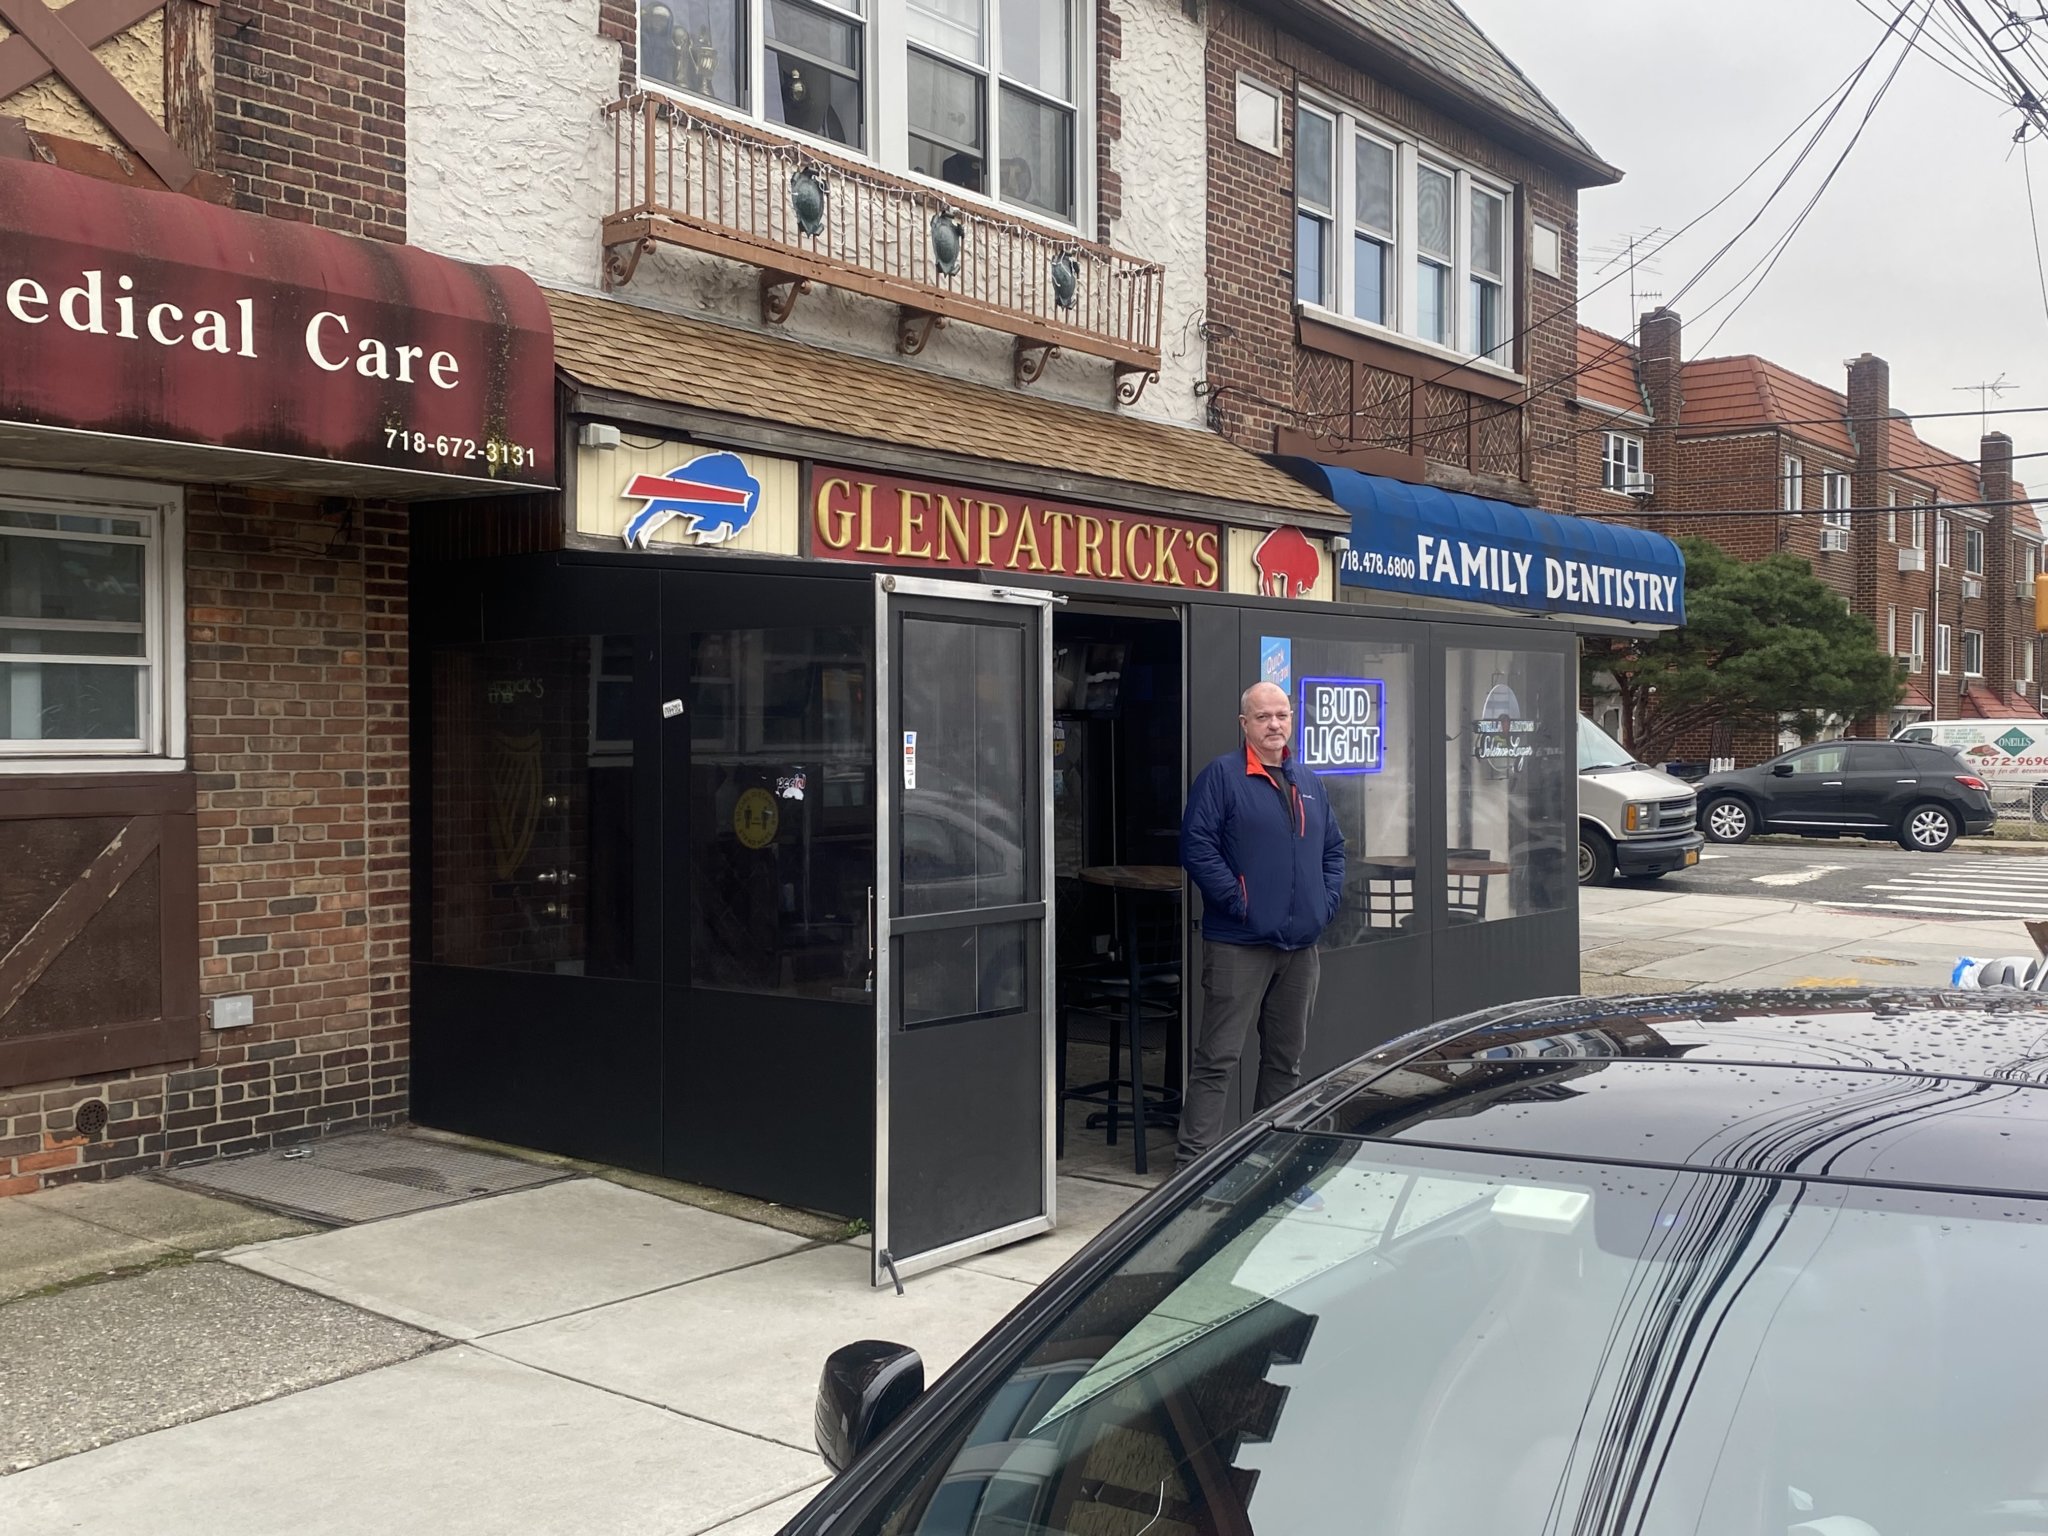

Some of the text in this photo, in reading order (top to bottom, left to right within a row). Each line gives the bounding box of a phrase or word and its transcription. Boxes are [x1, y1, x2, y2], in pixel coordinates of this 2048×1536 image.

[6, 270, 459, 389] edical Care
[384, 428, 535, 468] 718-672-3131
[815, 477, 1219, 588] GLENPATRICK'S
[1417, 534, 1533, 595] FAMILY
[1545, 557, 1678, 613] DENTISTRY
[1316, 687, 1371, 724] BUD
[1304, 726, 1380, 764] LIGHT
[1981, 757, 2048, 766] 672-9696
